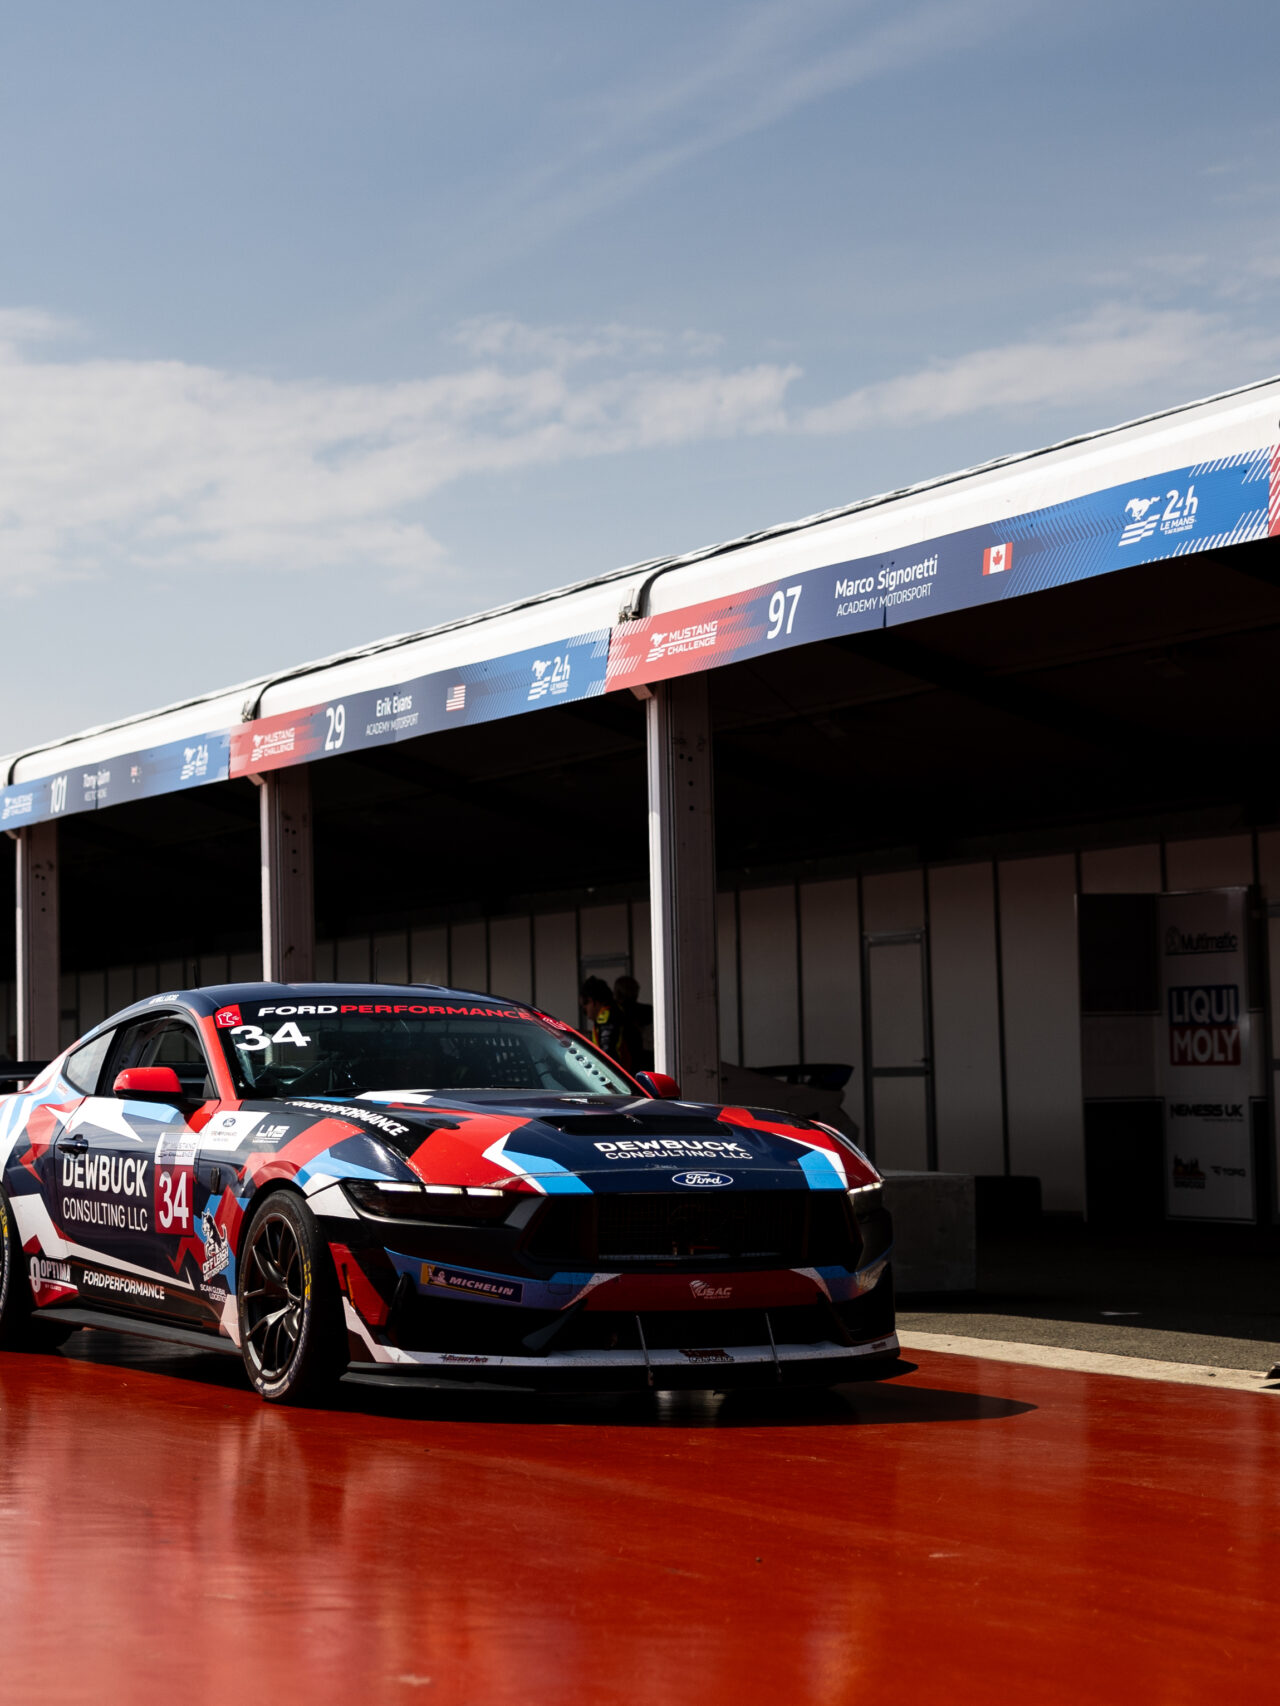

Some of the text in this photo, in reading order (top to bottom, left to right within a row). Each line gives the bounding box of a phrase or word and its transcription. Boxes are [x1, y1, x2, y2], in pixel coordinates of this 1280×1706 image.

[834, 553, 939, 599] Marco Signoretti
[767, 585, 803, 640] 97
[836, 583, 933, 616] ACADEMY MOTORSPORT
[668, 620, 719, 642] MUSTANG
[667, 635, 717, 656] CHALLENGE
[376, 695, 413, 717] Erik Evans
[263, 727, 296, 743] MUSTANG
[325, 704, 346, 752] 29
[365, 720, 390, 737] ACADEMY
[50, 775, 68, 814] 101
[1171, 988, 1238, 1024] LIQUI
[229, 1021, 312, 1051] 34
[1172, 1027, 1240, 1064] MOLY
[1224, 1103, 1244, 1117] UK
[593, 1139, 747, 1152] DEWBUCK
[605, 1149, 754, 1160] CONSULTING LLC
[62, 1153, 149, 1198] DEWBUCK
[685, 1173, 723, 1186] Ford
[158, 1170, 190, 1230] 34
[62, 1196, 148, 1232] CONSULTING LLC
[39, 1259, 72, 1283] OPTIMA
[449, 1276, 515, 1296] MICHELIN
